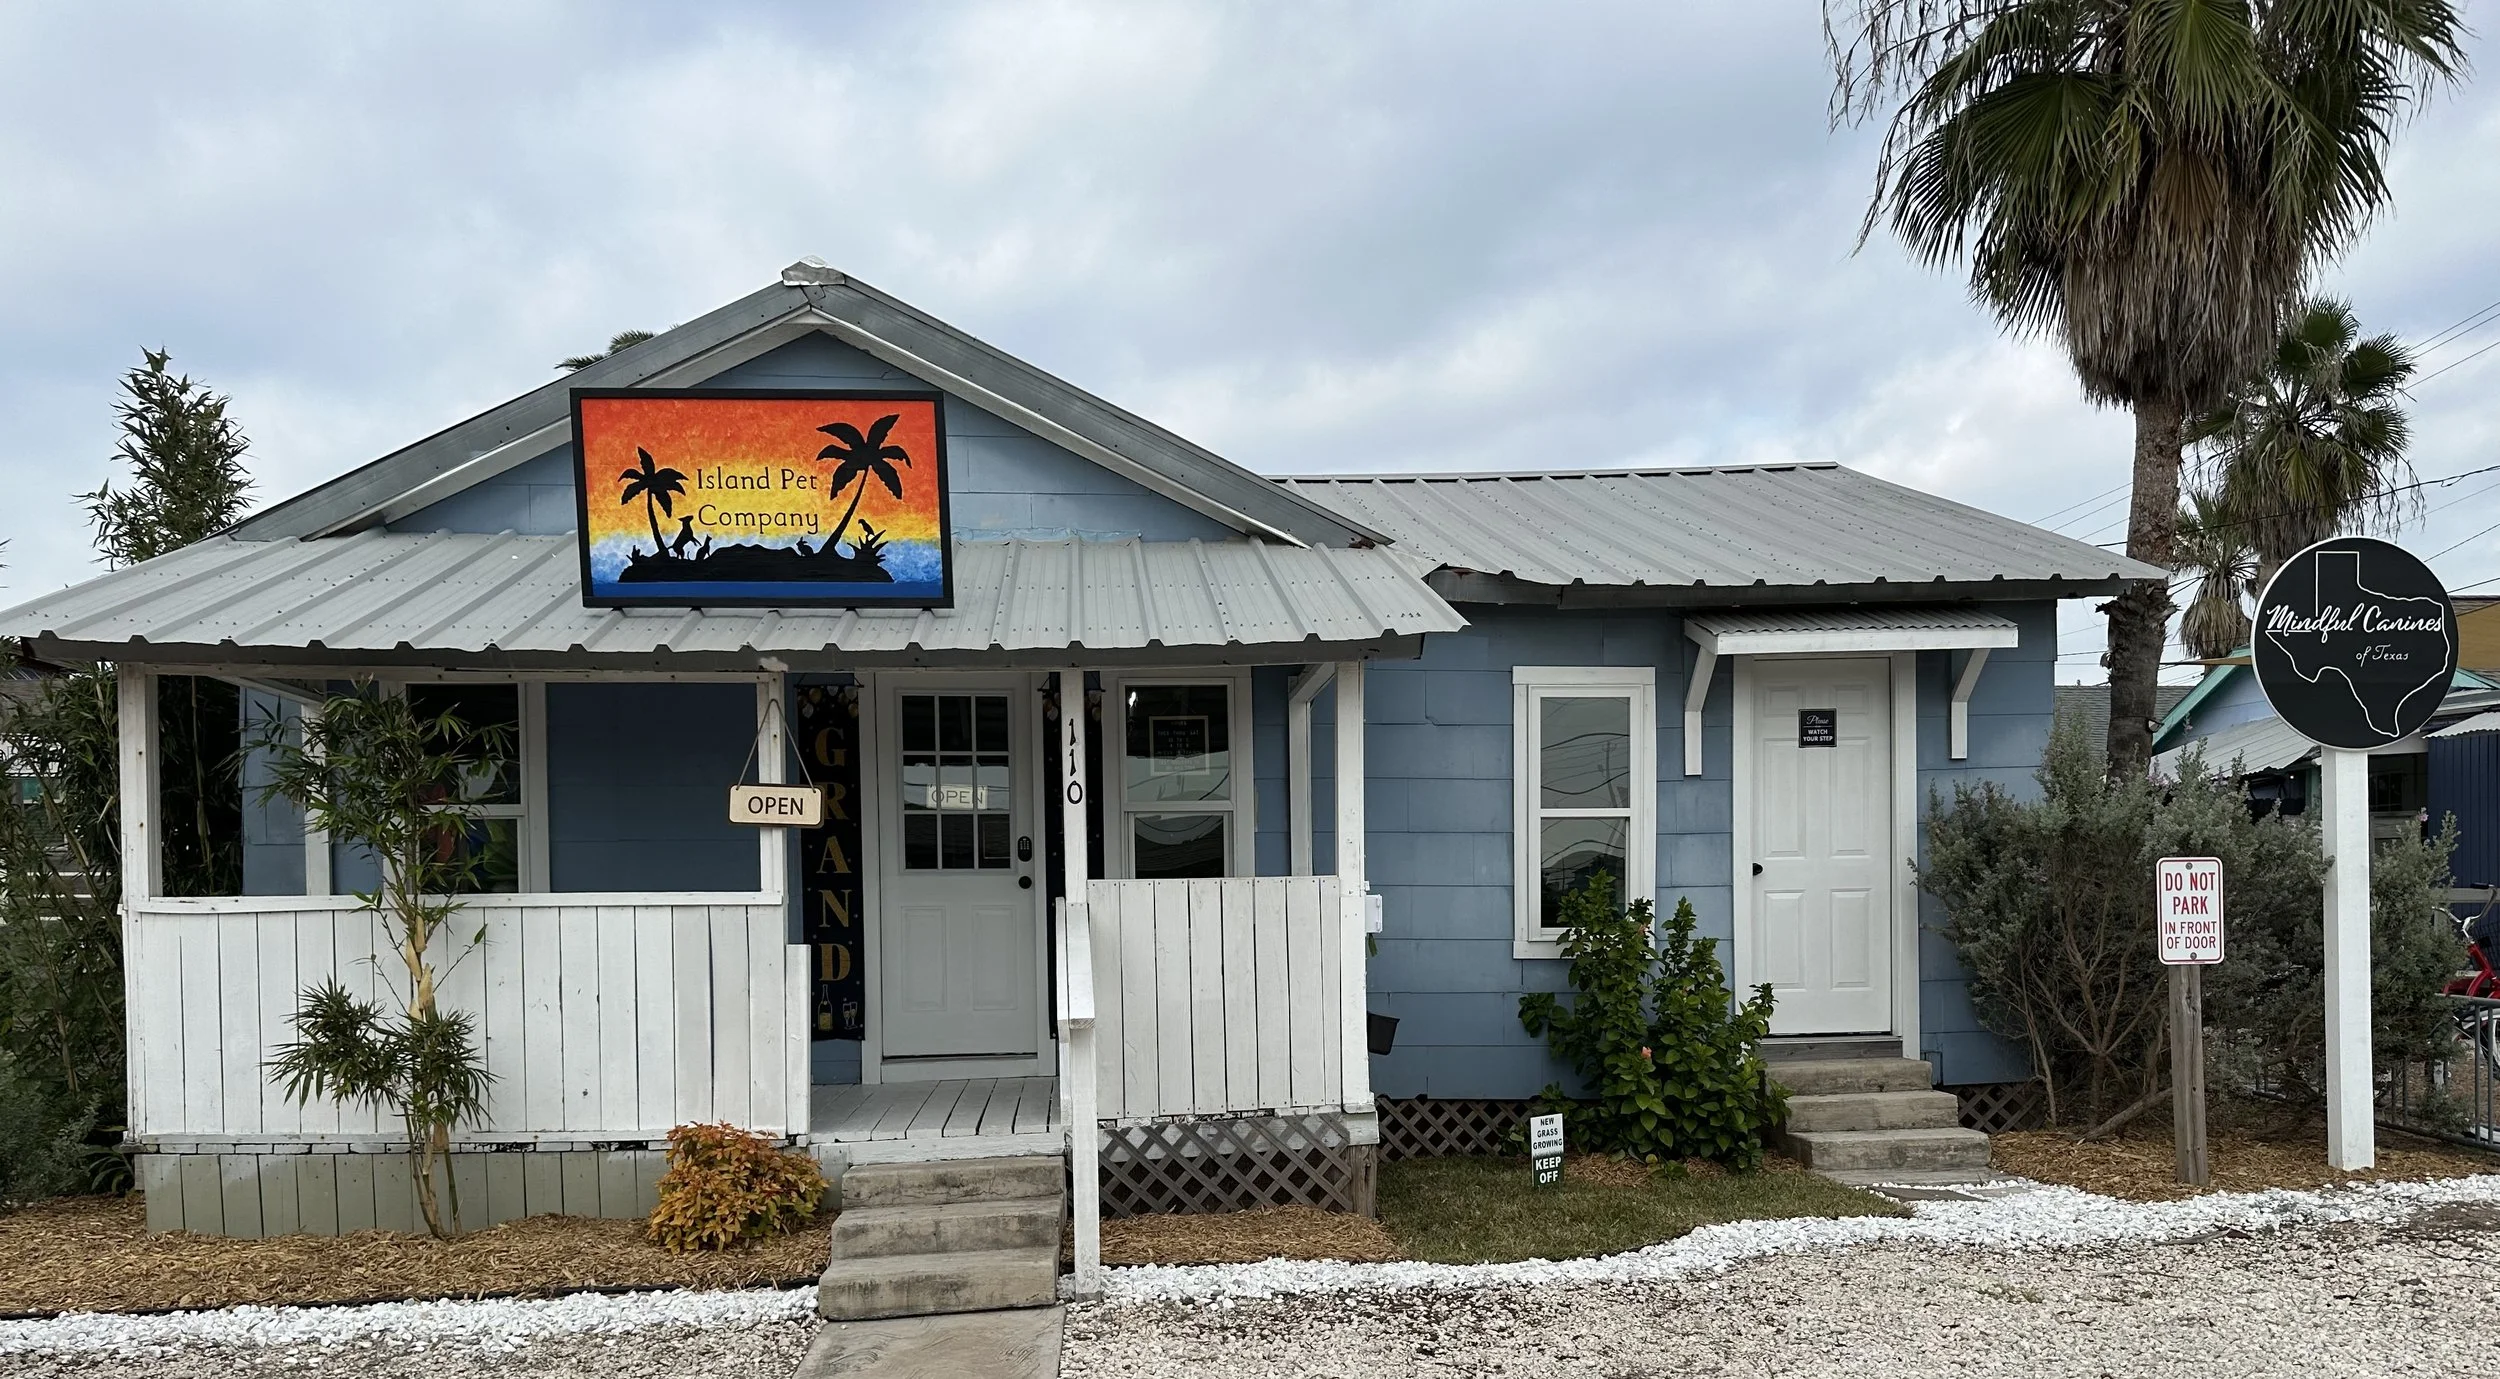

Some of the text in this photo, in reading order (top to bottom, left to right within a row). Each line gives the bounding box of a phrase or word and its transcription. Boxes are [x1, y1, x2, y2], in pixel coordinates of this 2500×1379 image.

[696, 466, 818, 490] Island Pet
[698, 504, 819, 534] Company
[2266, 602, 2442, 643] Mindful Canines
[2356, 644, 2409, 667] of Texas
[1066, 718, 1083, 804] 110
[748, 795, 804, 816] OPEN
[931, 790, 983, 804] OPEN
[815, 727, 852, 981] GRAND
[2165, 872, 2216, 892] DO NOT
[2173, 896, 2209, 915] PARK
[2165, 921, 2217, 934] IN FRONT
[2166, 936, 2216, 949] OF DOOR
[1540, 1117, 1554, 1126] NEW
[1537, 1128, 1558, 1138] GRASS
[1533, 1138, 1563, 1150] GROWING
[1535, 1156, 1562, 1171] KEEP
[1540, 1170, 1559, 1184] OFF
